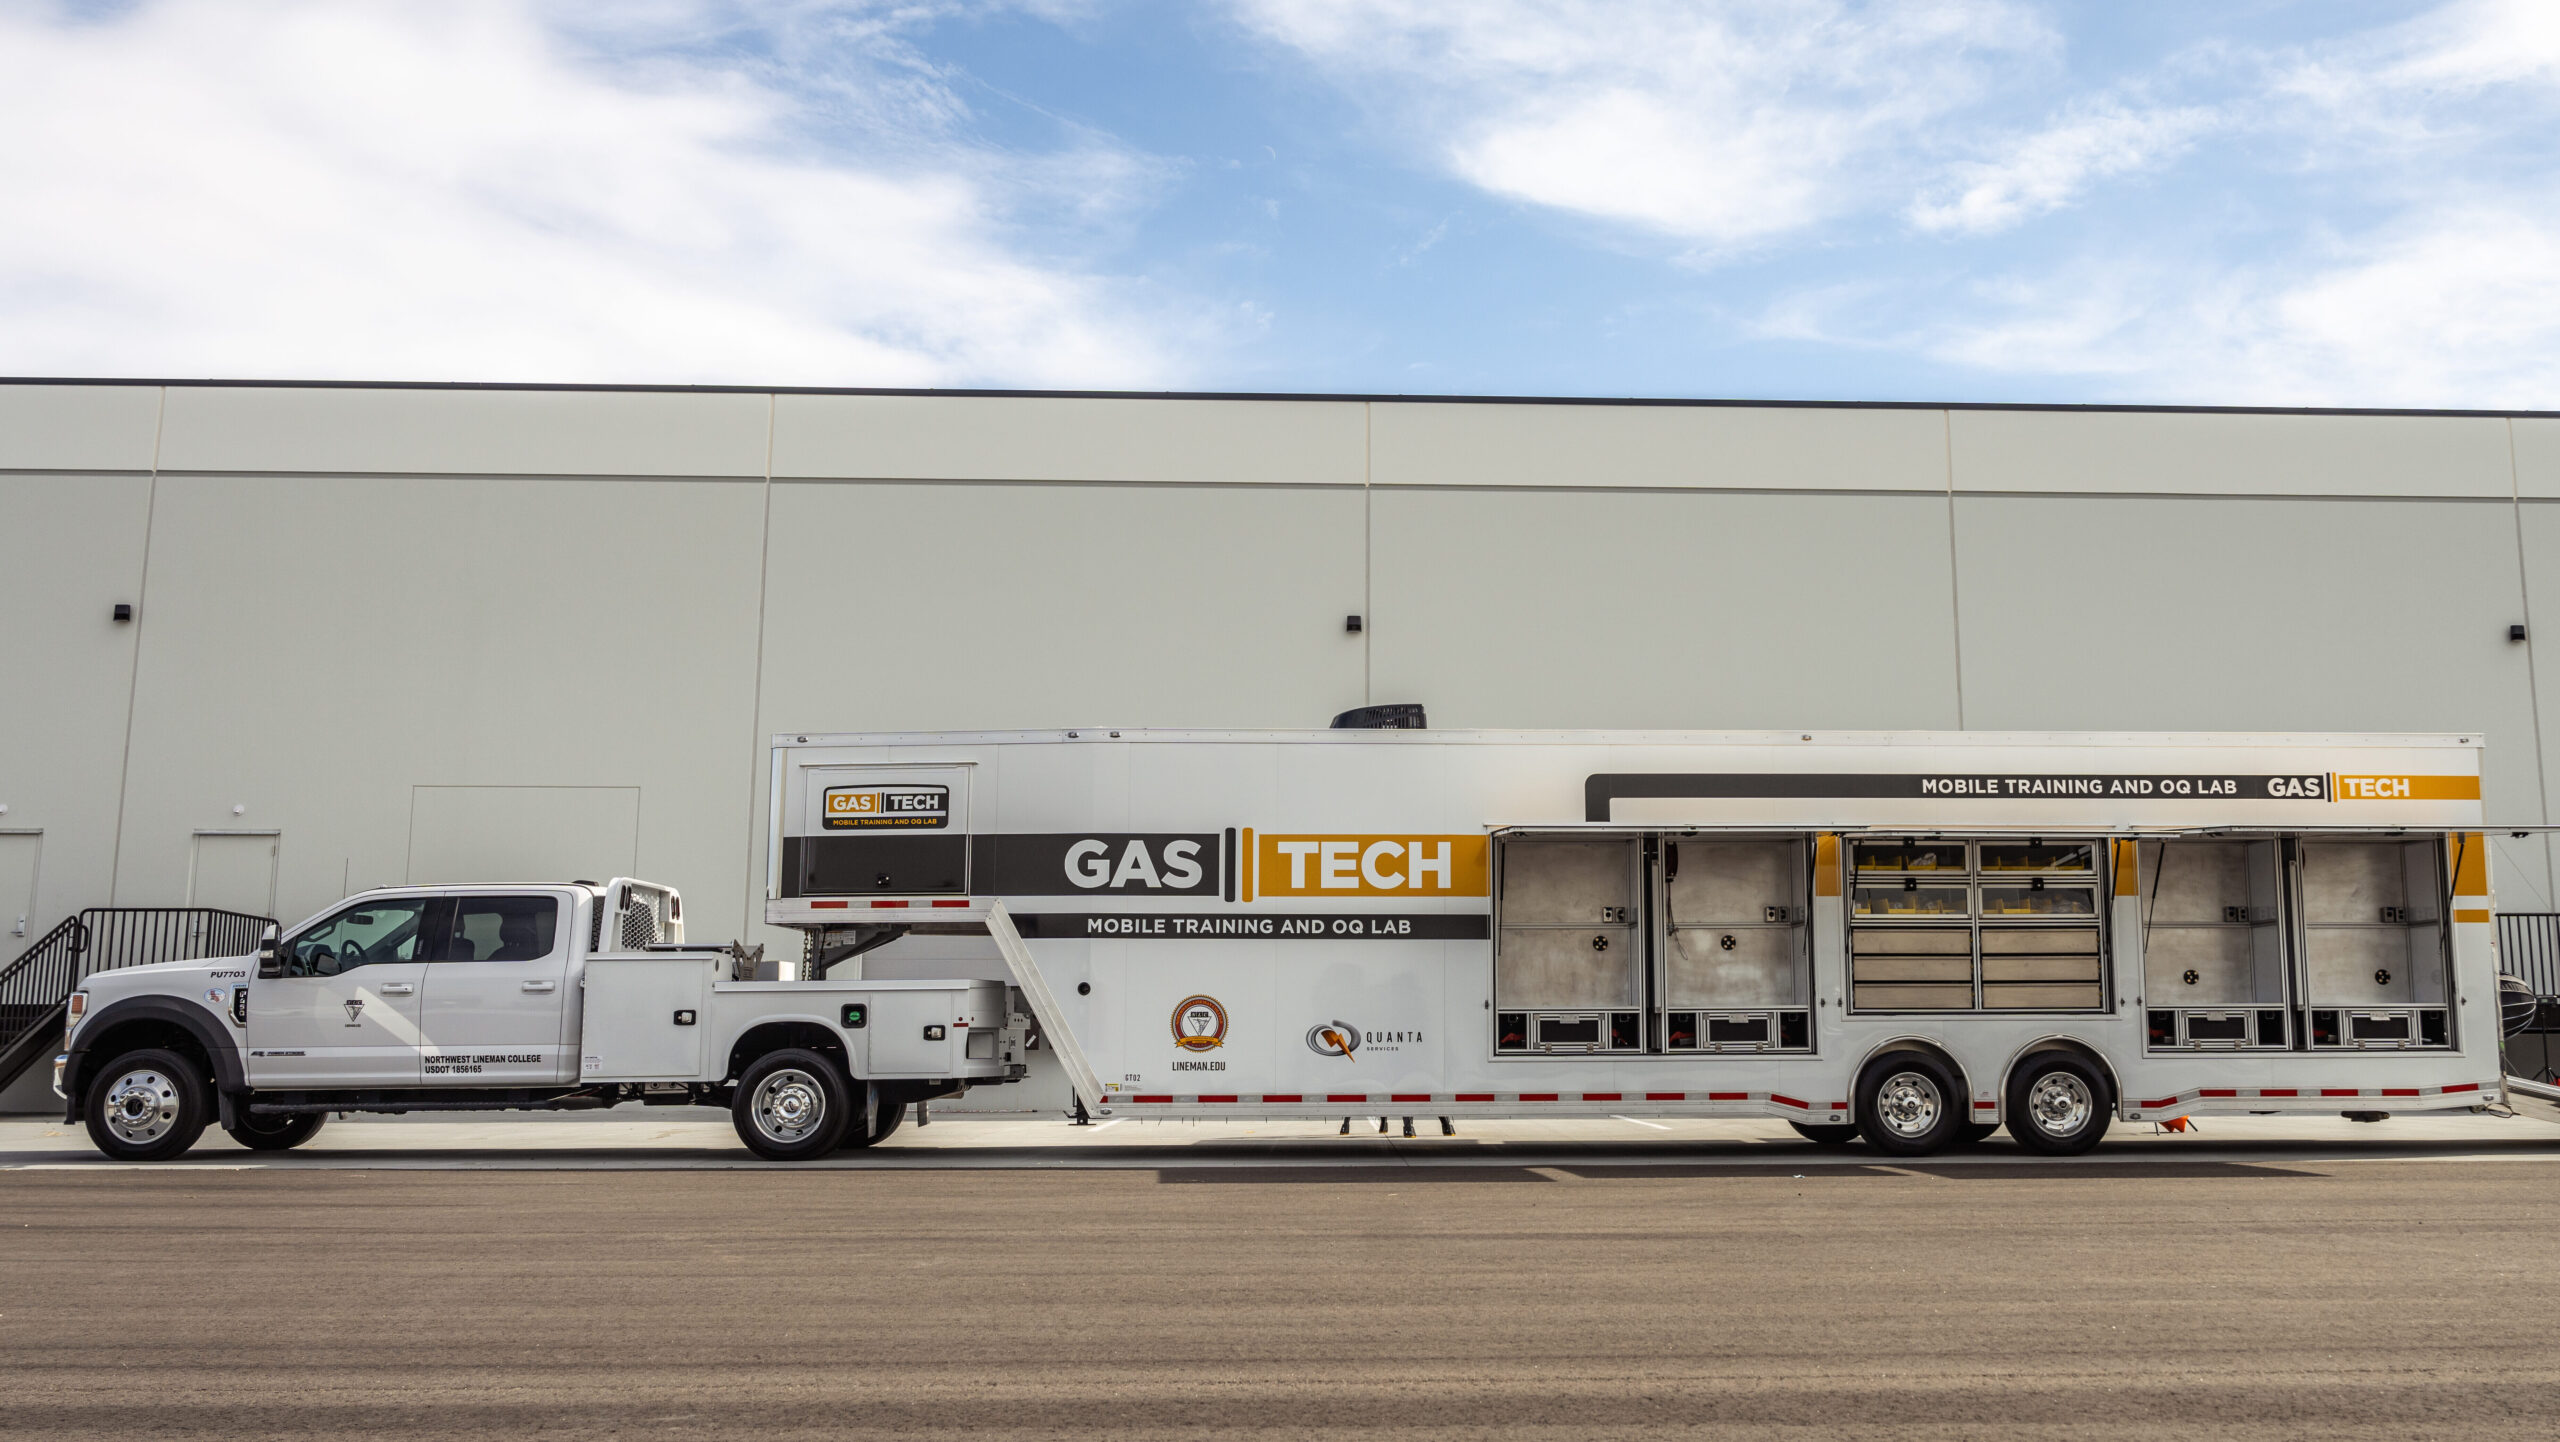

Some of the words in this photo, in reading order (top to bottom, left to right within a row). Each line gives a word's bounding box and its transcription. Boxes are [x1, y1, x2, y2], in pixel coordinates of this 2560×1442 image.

[1922, 778, 1998, 795] MOBILE
[2004, 779, 2103, 795] TRAINING
[2109, 779, 2153, 795] AND
[2159, 779, 2191, 796] OQ
[2197, 779, 2238, 795] LAB
[2267, 777, 2321, 798] GAS
[2343, 777, 2411, 798] TECH
[833, 796, 871, 811] GAS
[891, 795, 939, 810] TECH
[1063, 838, 1204, 889] GAS
[1276, 839, 1453, 890] TECH
[1086, 918, 1165, 935] MOBILE
[1172, 918, 1274, 935] TRAINING
[1280, 918, 1325, 935] AND
[1331, 918, 1364, 937] OQ
[1370, 918, 1412, 935] LAB
[210, 970, 246, 979] PU7703
[1366, 1031, 1423, 1044] QUANTA
[424, 1055, 471, 1064] NORTHWEST
[472, 1055, 506, 1063] LINEMAN
[507, 1054, 541, 1063] COLLEGE
[425, 1065, 450, 1074] USDOT
[452, 1065, 482, 1074] 1856165
[1172, 1061, 1226, 1072] LINEMAN.EDU
